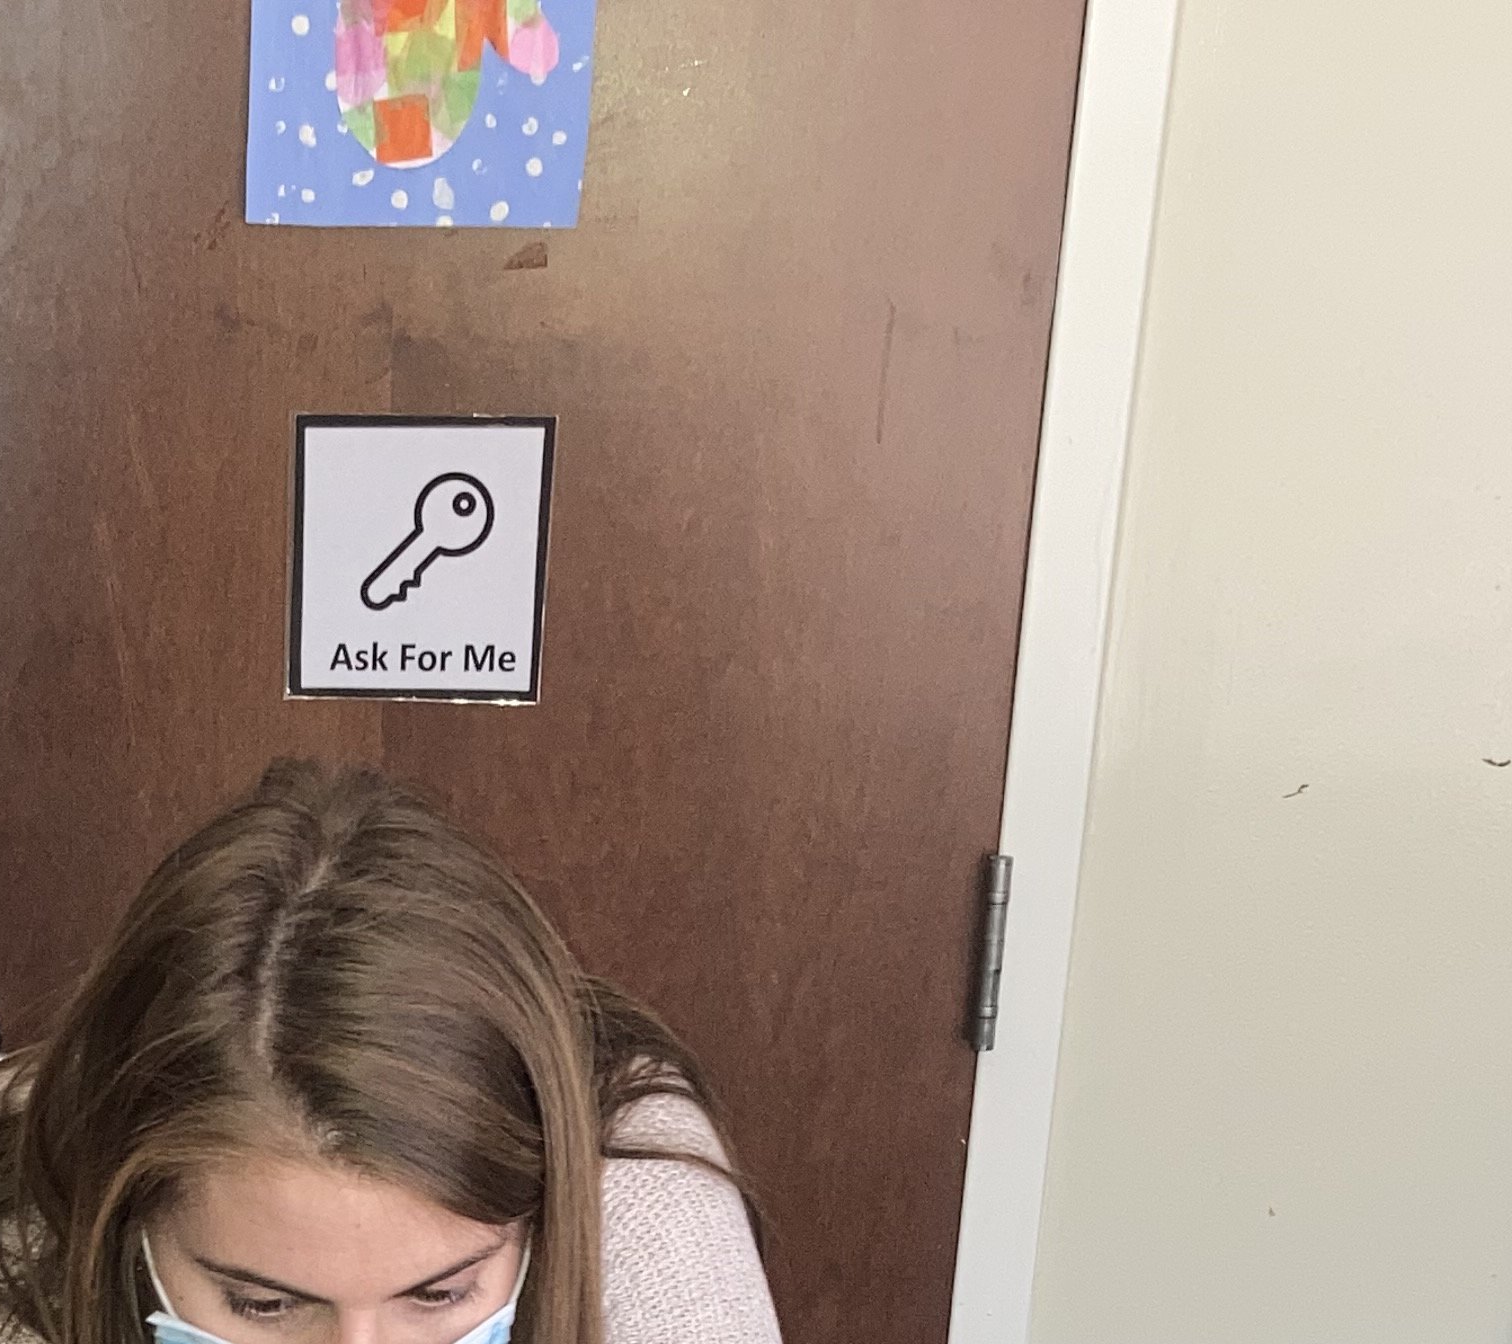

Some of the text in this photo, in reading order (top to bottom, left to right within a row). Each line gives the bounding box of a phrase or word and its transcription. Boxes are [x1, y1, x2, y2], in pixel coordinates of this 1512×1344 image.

[330, 642, 516, 672] Ask For Me
